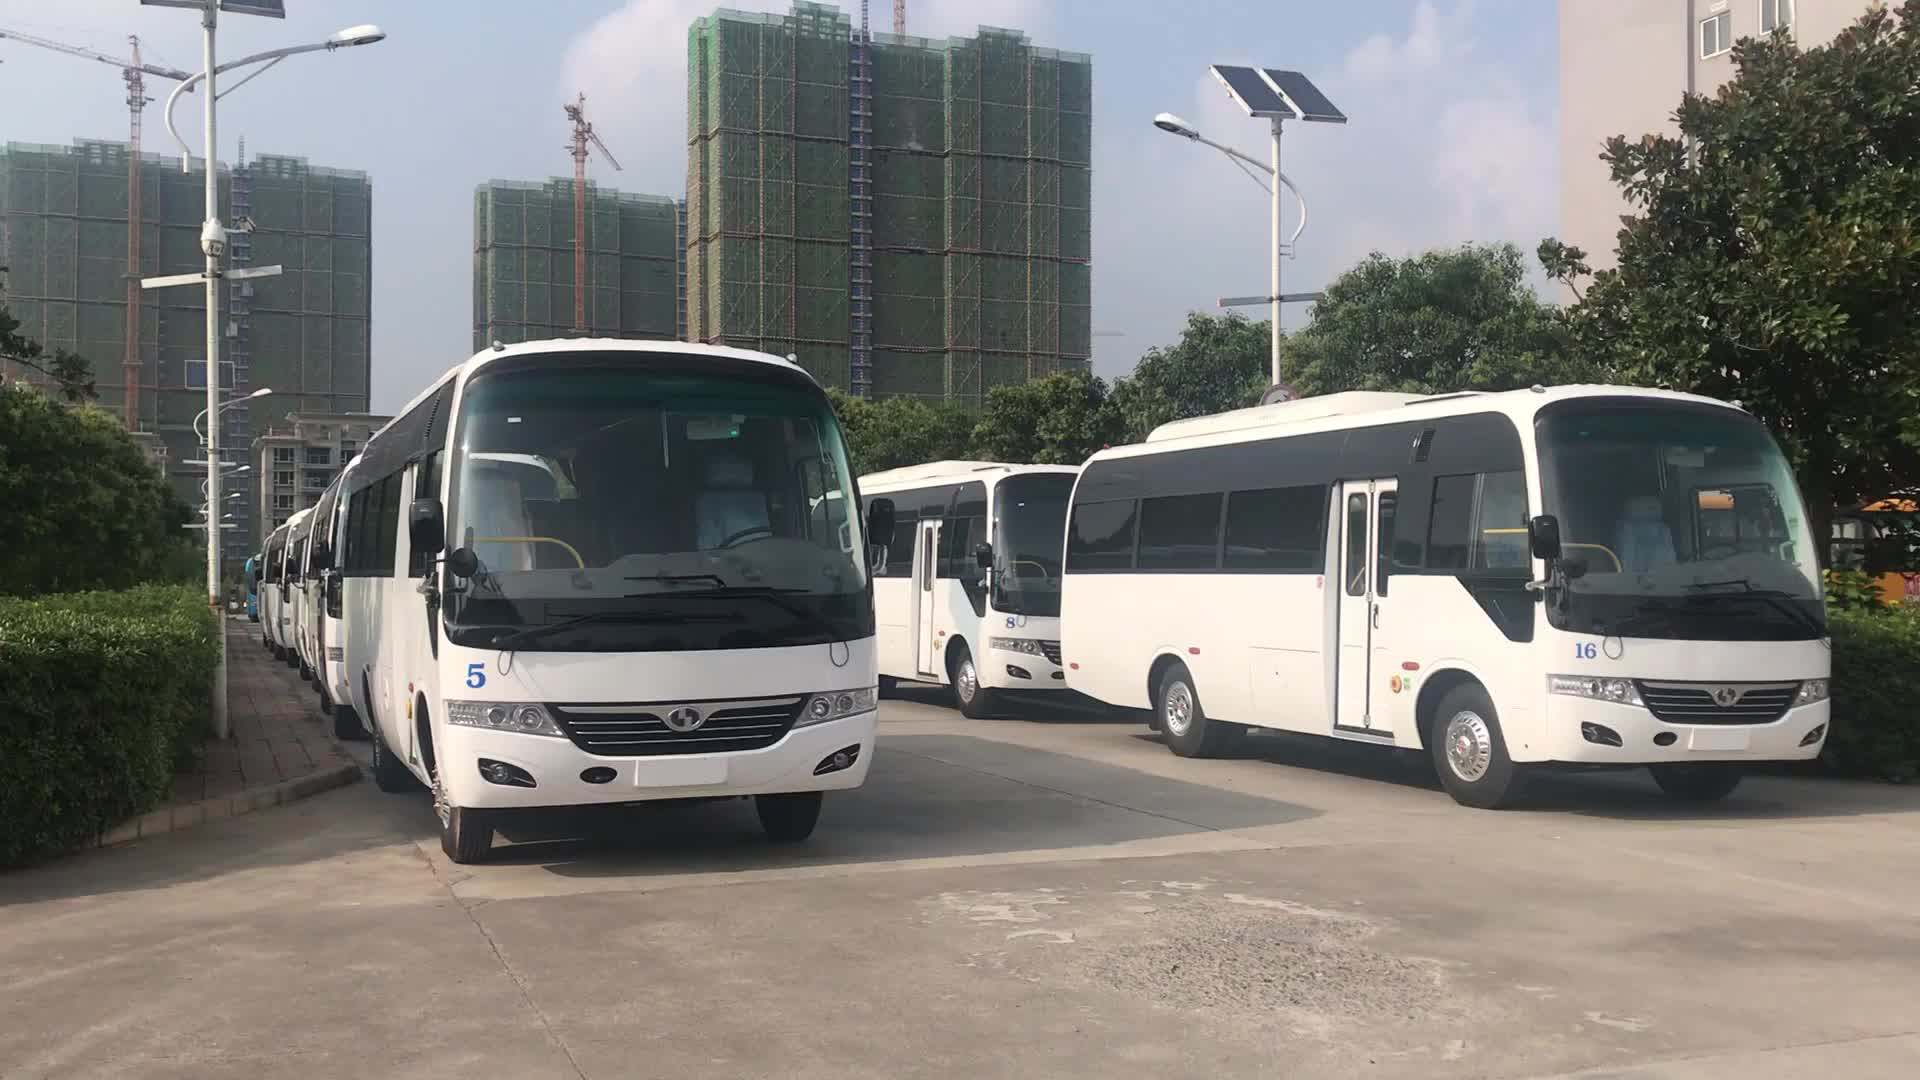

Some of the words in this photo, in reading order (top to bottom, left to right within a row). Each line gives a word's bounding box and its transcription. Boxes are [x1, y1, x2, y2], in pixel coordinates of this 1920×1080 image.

[1006, 616, 1016, 629] 8
[1575, 642, 1598, 660] 16
[466, 662, 487, 689] 5
